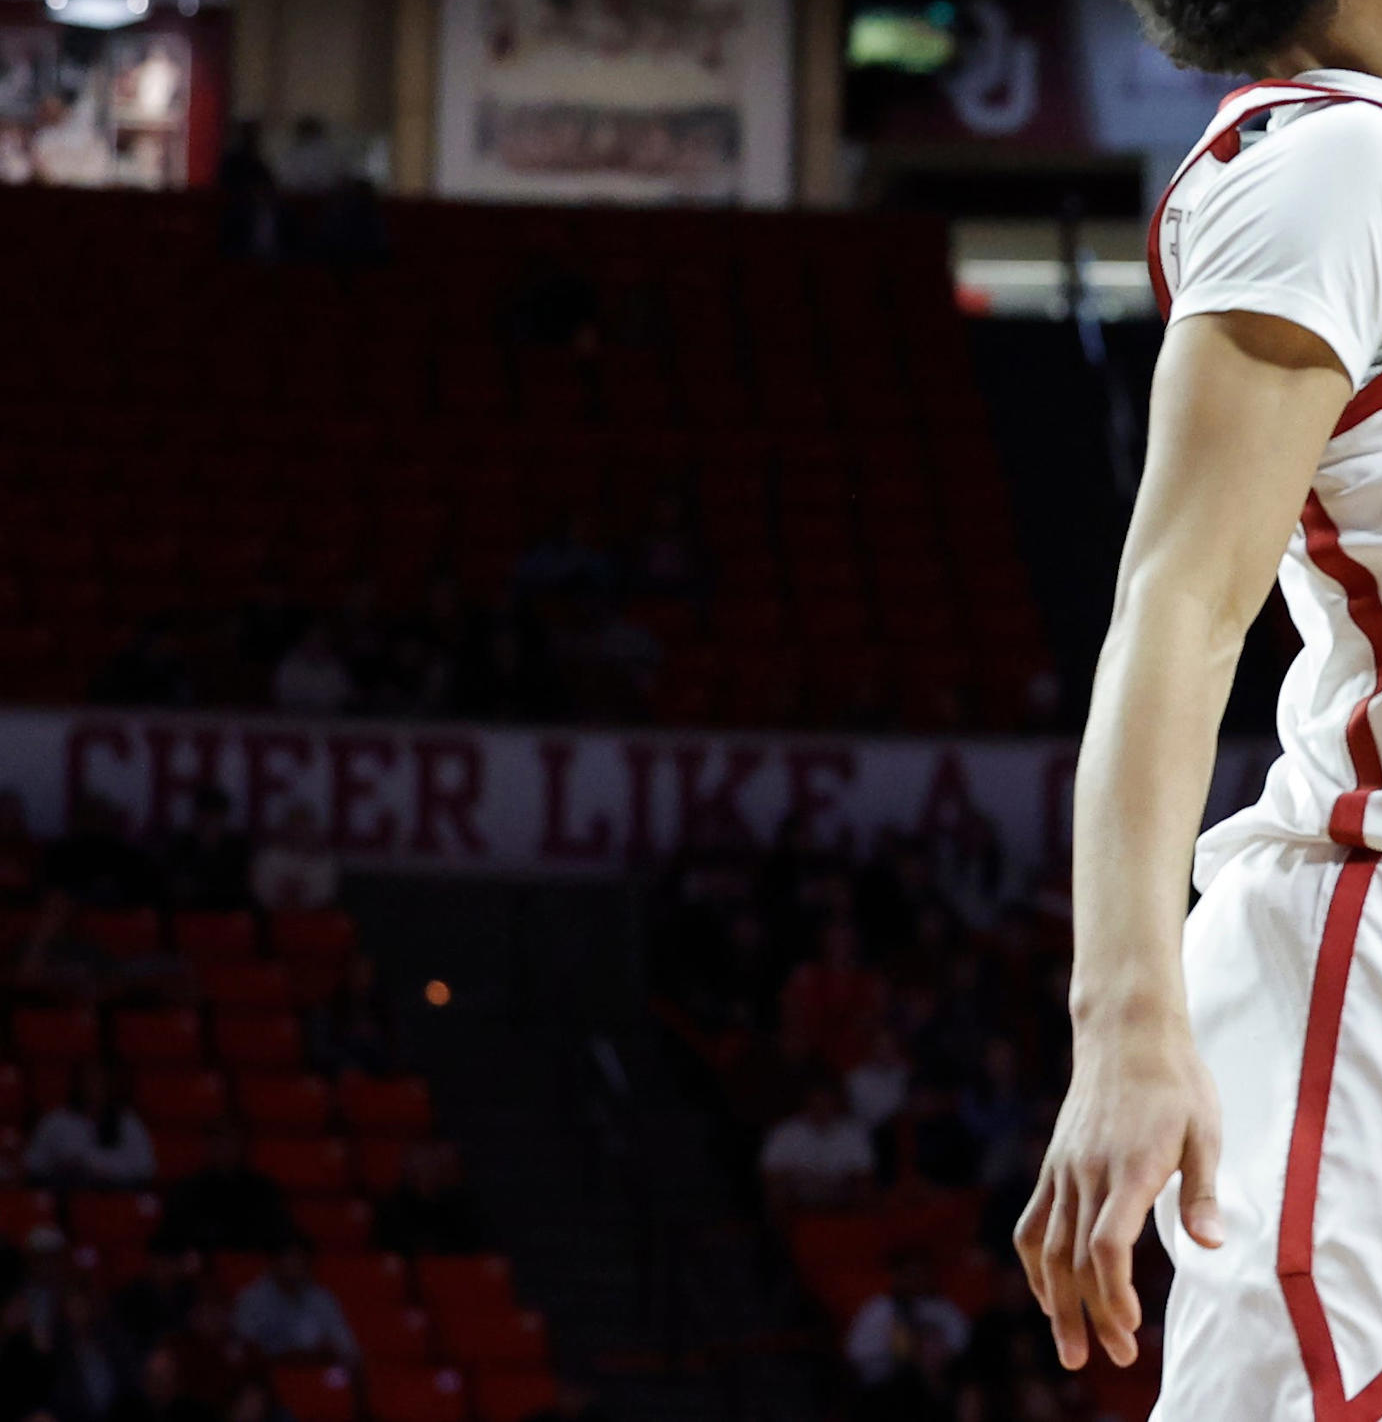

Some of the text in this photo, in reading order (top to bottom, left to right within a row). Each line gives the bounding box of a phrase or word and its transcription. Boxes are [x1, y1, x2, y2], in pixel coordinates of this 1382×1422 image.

[66, 719, 490, 860] CHEER
[540, 738, 854, 864] LIKE
[914, 746, 1003, 850] A
